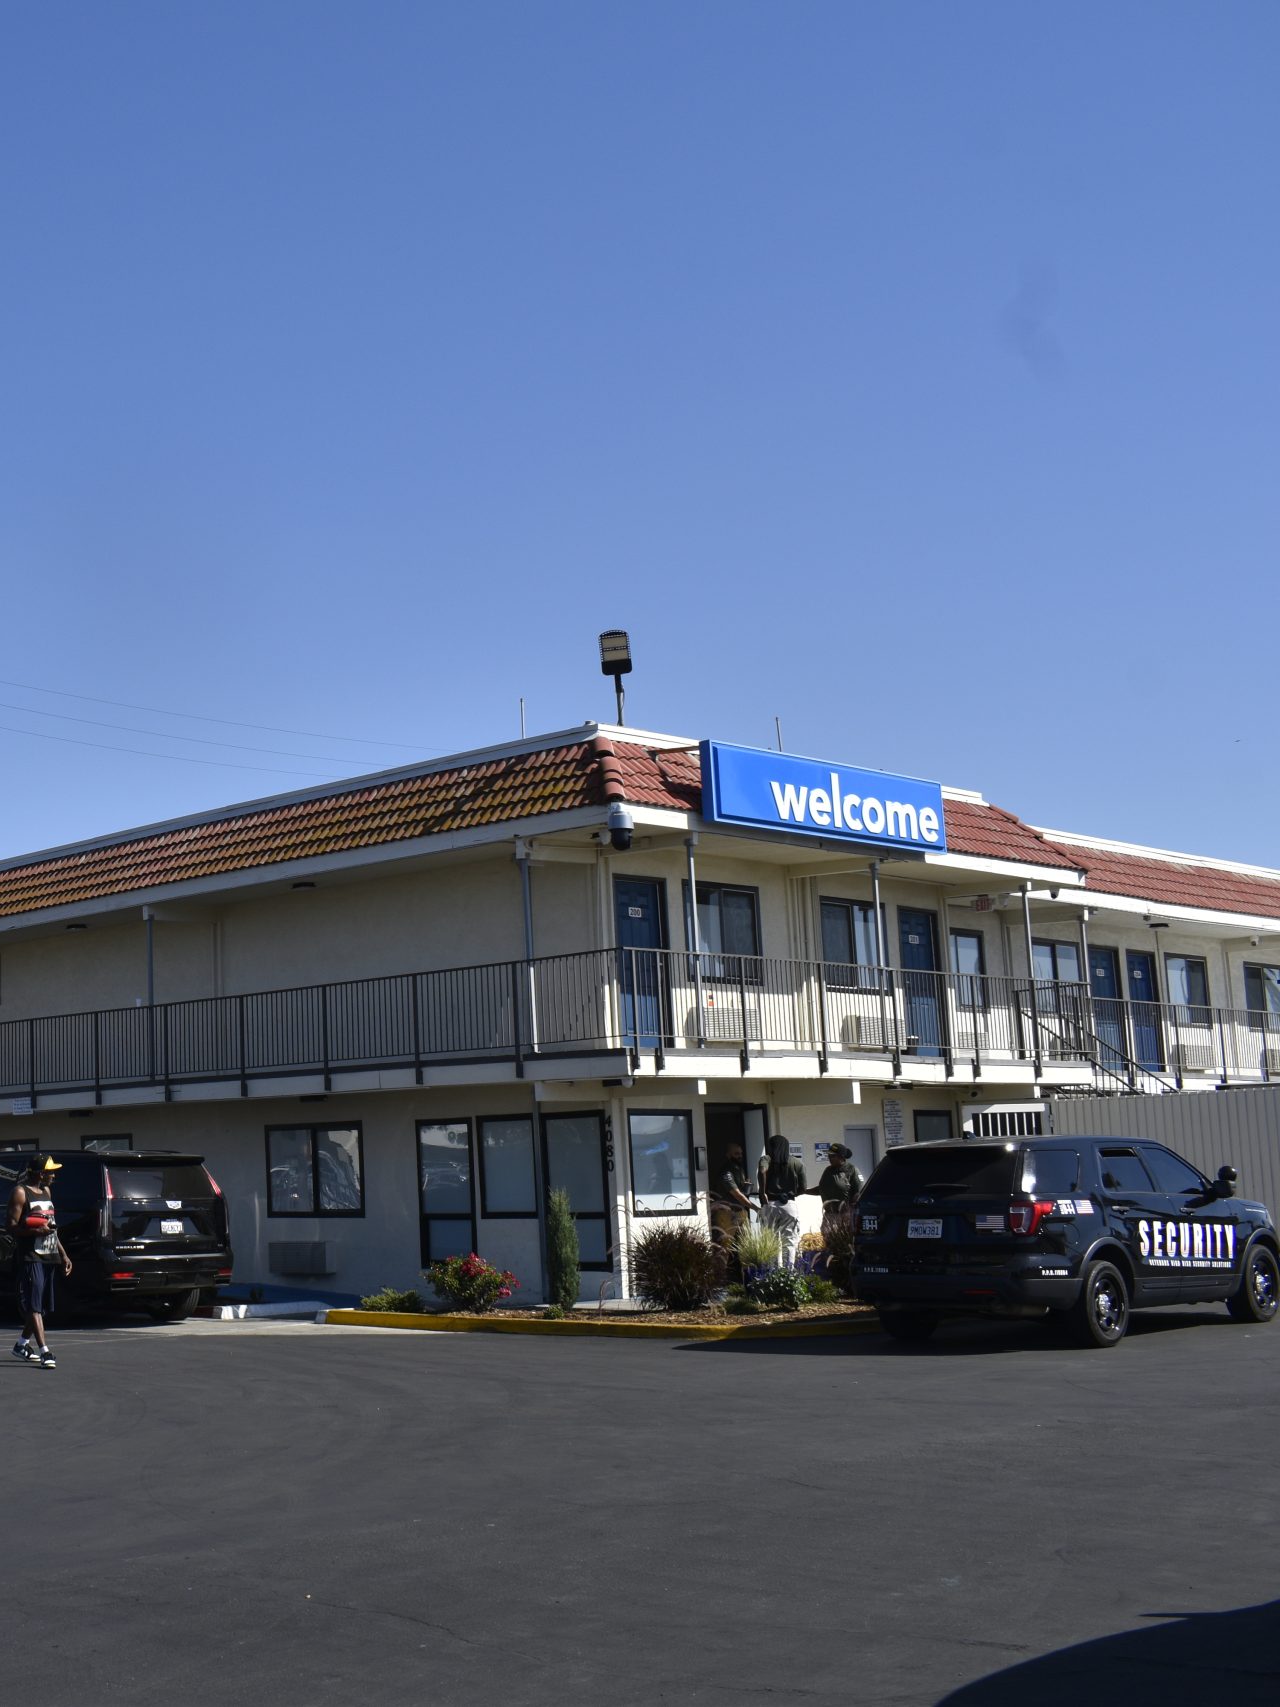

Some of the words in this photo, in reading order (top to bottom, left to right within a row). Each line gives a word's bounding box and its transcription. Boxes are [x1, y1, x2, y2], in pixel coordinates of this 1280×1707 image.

[770, 772, 939, 843] welcome
[606, 1115, 614, 1172] 4080
[1139, 1220, 1234, 1259] SECURITY
